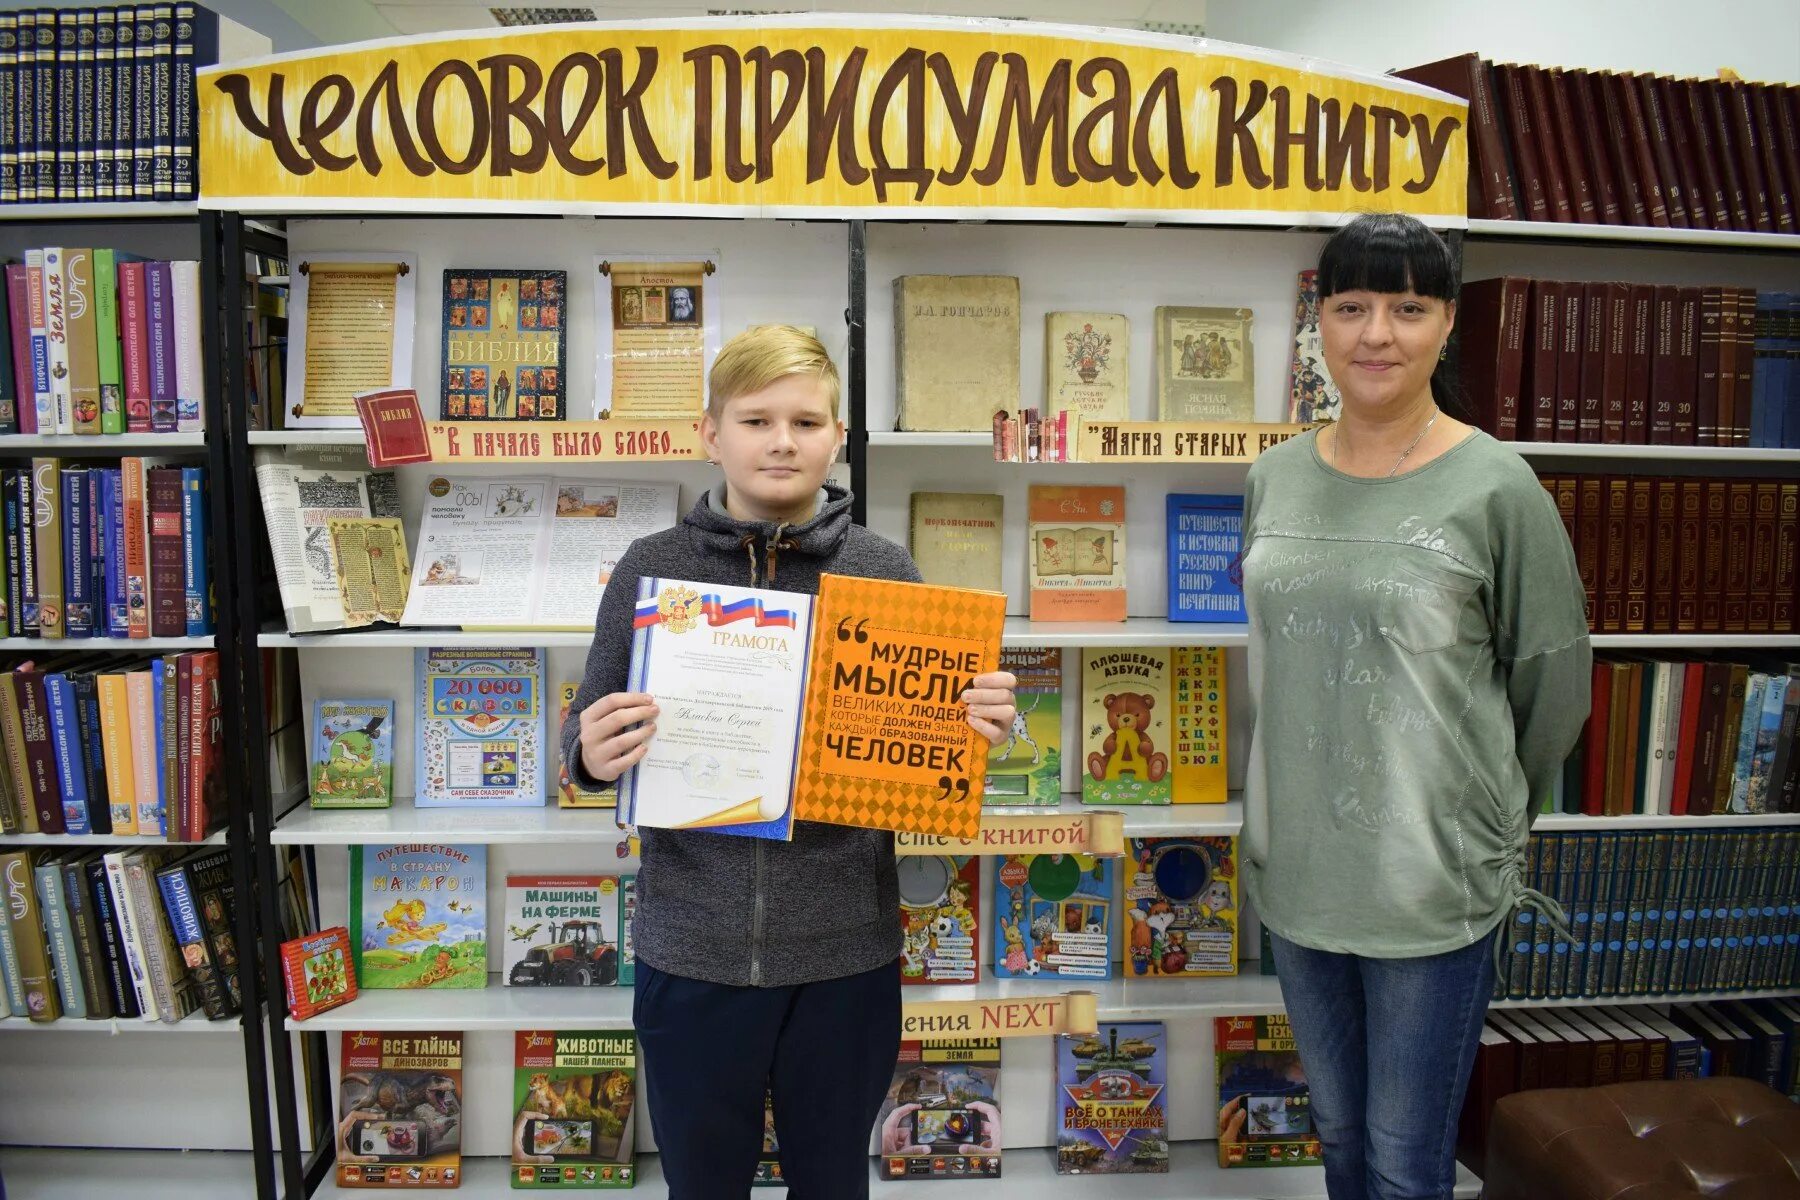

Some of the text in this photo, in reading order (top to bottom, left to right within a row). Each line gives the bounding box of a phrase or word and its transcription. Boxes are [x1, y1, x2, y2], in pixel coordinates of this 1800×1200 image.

[104, 68, 112, 140] ЭНЦИКЛОПЕДИЯ
[143, 66, 151, 139] ЭНЦИКЛОПЕДИЯ
[161, 63, 169, 136] ЭНЦИКЛОПЕДИЯ
[182, 64, 190, 136] ЭНЦИКЛОПЕДИЯ
[1210, 76, 1461, 194] КНИГУ
[99, 163, 110, 172] 25
[118, 162, 128, 172] 26
[137, 161, 148, 171] 27
[156, 159, 168, 168] 28
[176, 160, 188, 169] 29
[1581, 181, 1587, 192] 5
[1654, 186, 1660, 196] 8
[1671, 186, 1679, 198] 10
[31, 270, 41, 326] ВСЕМИРНАЯ
[51, 273, 65, 344] Земля
[940, 305, 1010, 317] ГОНЧАРОВ
[130, 321, 140, 394] ЭНЦИКЛОПЕДИЯ
[448, 341, 559, 363] БИБЛИЯ
[35, 338, 45, 391] ГЕОГРАФИЯ
[1188, 394, 1227, 404] ЯСНАЯ
[1505, 397, 1514, 408] 24
[1540, 398, 1550, 408] 25
[1562, 400, 1574, 410] 26
[1586, 400, 1597, 410] 27
[1610, 401, 1622, 412] 28
[1632, 401, 1644, 412] 24
[1658, 402, 1670, 412] 29
[380, 407, 412, 422] БИБЛИЯ
[1184, 404, 1232, 414] ПОЛЯНА
[1678, 403, 1690, 414] 30
[474, 432, 540, 457] НАЧАЛЕ
[553, 432, 602, 456] БЫЛО
[1175, 432, 1248, 457] СТАРЫХ
[70, 476, 82, 598] ЭНЦИКЛОПЕДИЯ ДЛЯ ДЕТЕЙ
[1179, 534, 1238, 552] К ИСТОКАМ
[186, 533, 194, 588] ЭНЦИКЛОПЕДИЯ
[1179, 554, 1228, 571] РУССКОГО
[1180, 594, 1240, 611] ПЕЧАТАНИЯ
[1633, 606, 1640, 618] 3
[712, 631, 788, 652] ГРАМОТА
[871, 642, 980, 674] МУДРЫЕ
[1090, 654, 1164, 671] ПЛЮШЕВАЯ
[470, 666, 496, 674] Более
[1104, 664, 1150, 678] АЗБУКА
[446, 680, 472, 694] 20
[834, 662, 975, 704] МЫСЛИ
[26, 682, 38, 741] ОТЕЧЕСТВЕННАЯ
[436, 698, 530, 713] СКАЗОК
[833, 694, 904, 716] ВЕЛИКИХ
[22, 709, 32, 742] ВЕЛИКАЯ
[192, 683, 202, 756] МУЗЕИ РОССИИ
[830, 710, 969, 735] КОТОРЫЕ ДОЛЖЕН ЗНАТЬ
[38, 715, 46, 741] ВОЙНА
[829, 722, 967, 746] КАЖДЫЙ ОБРАЗОВАННЫЙ
[826, 734, 965, 772] ЧЕЛОВЕК
[982, 820, 1086, 845] книгой
[377, 844, 470, 863] ПУТЕШЕСТВИЕ
[391, 863, 452, 872] В СТРАНУ
[373, 875, 474, 892] МАКАРОН
[170, 873, 199, 940] ЖИВОПИСИ
[522, 906, 600, 918] НА ФЕРМЕ
[44, 875, 76, 1009] ЭНЦИКЛОПЕДИЯ ДЛЯ ДЕТЕЙ
[981, 1002, 1061, 1029] NEXT
[1267, 1026, 1294, 1038] ТЕХН
[357, 1038, 379, 1046] ASTAR
[382, 1036, 461, 1056] ВСЕ ТАЙНЫ
[531, 1037, 552, 1046] ASTAR
[556, 1038, 634, 1054] ЖИВОТНЫЕ
[394, 1058, 449, 1068] ДИНОЗАВРОВ
[563, 1057, 590, 1066] НАШЕЙ
[592, 1058, 626, 1066] ПЛАНЕТЫ
[946, 1051, 974, 1060] ЗЕМЛЯ
[1064, 1104, 1164, 1118] ВСЁ О ТАНКАХ
[1064, 1120, 1164, 1129] И БРОНЕТЕХНИКЕ
